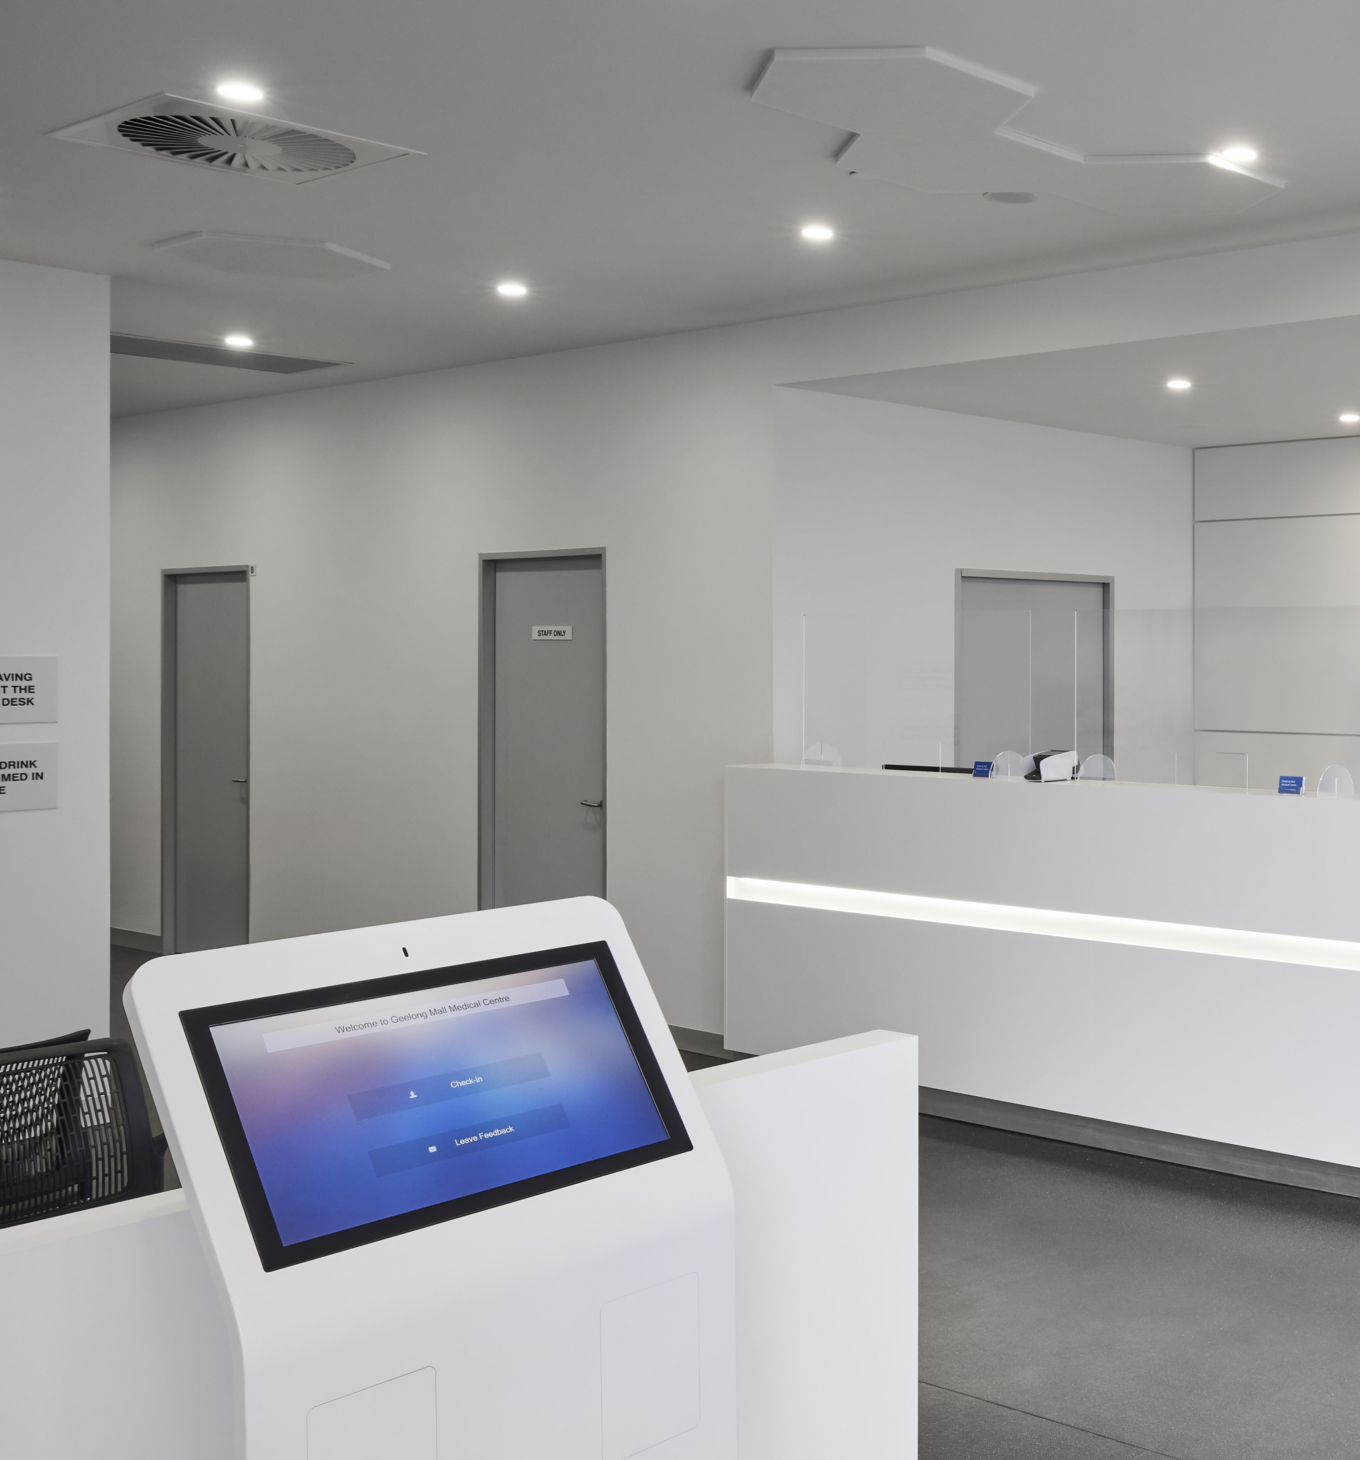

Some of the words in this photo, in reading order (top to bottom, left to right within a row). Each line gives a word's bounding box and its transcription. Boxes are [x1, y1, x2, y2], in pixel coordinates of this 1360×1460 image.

[537, 629, 553, 637] STAFF
[553, 629, 567, 637] ONLY
[11, 684, 36, 694] THE
[1, 697, 35, 707] DESK
[0, 759, 38, 770] DRINK
[31, 771, 44, 781] IN
[334, 1020, 378, 1034] Welcome
[380, 1018, 389, 1026] to
[390, 1010, 428, 1024] Geelong
[428, 1005, 448, 1017] Mall
[448, 1000, 482, 1013] Medical
[482, 994, 511, 1007] Centre
[450, 1076, 484, 1089] Check-in
[454, 1134, 479, 1147] Leave
[478, 1125, 515, 1140] Feedback
